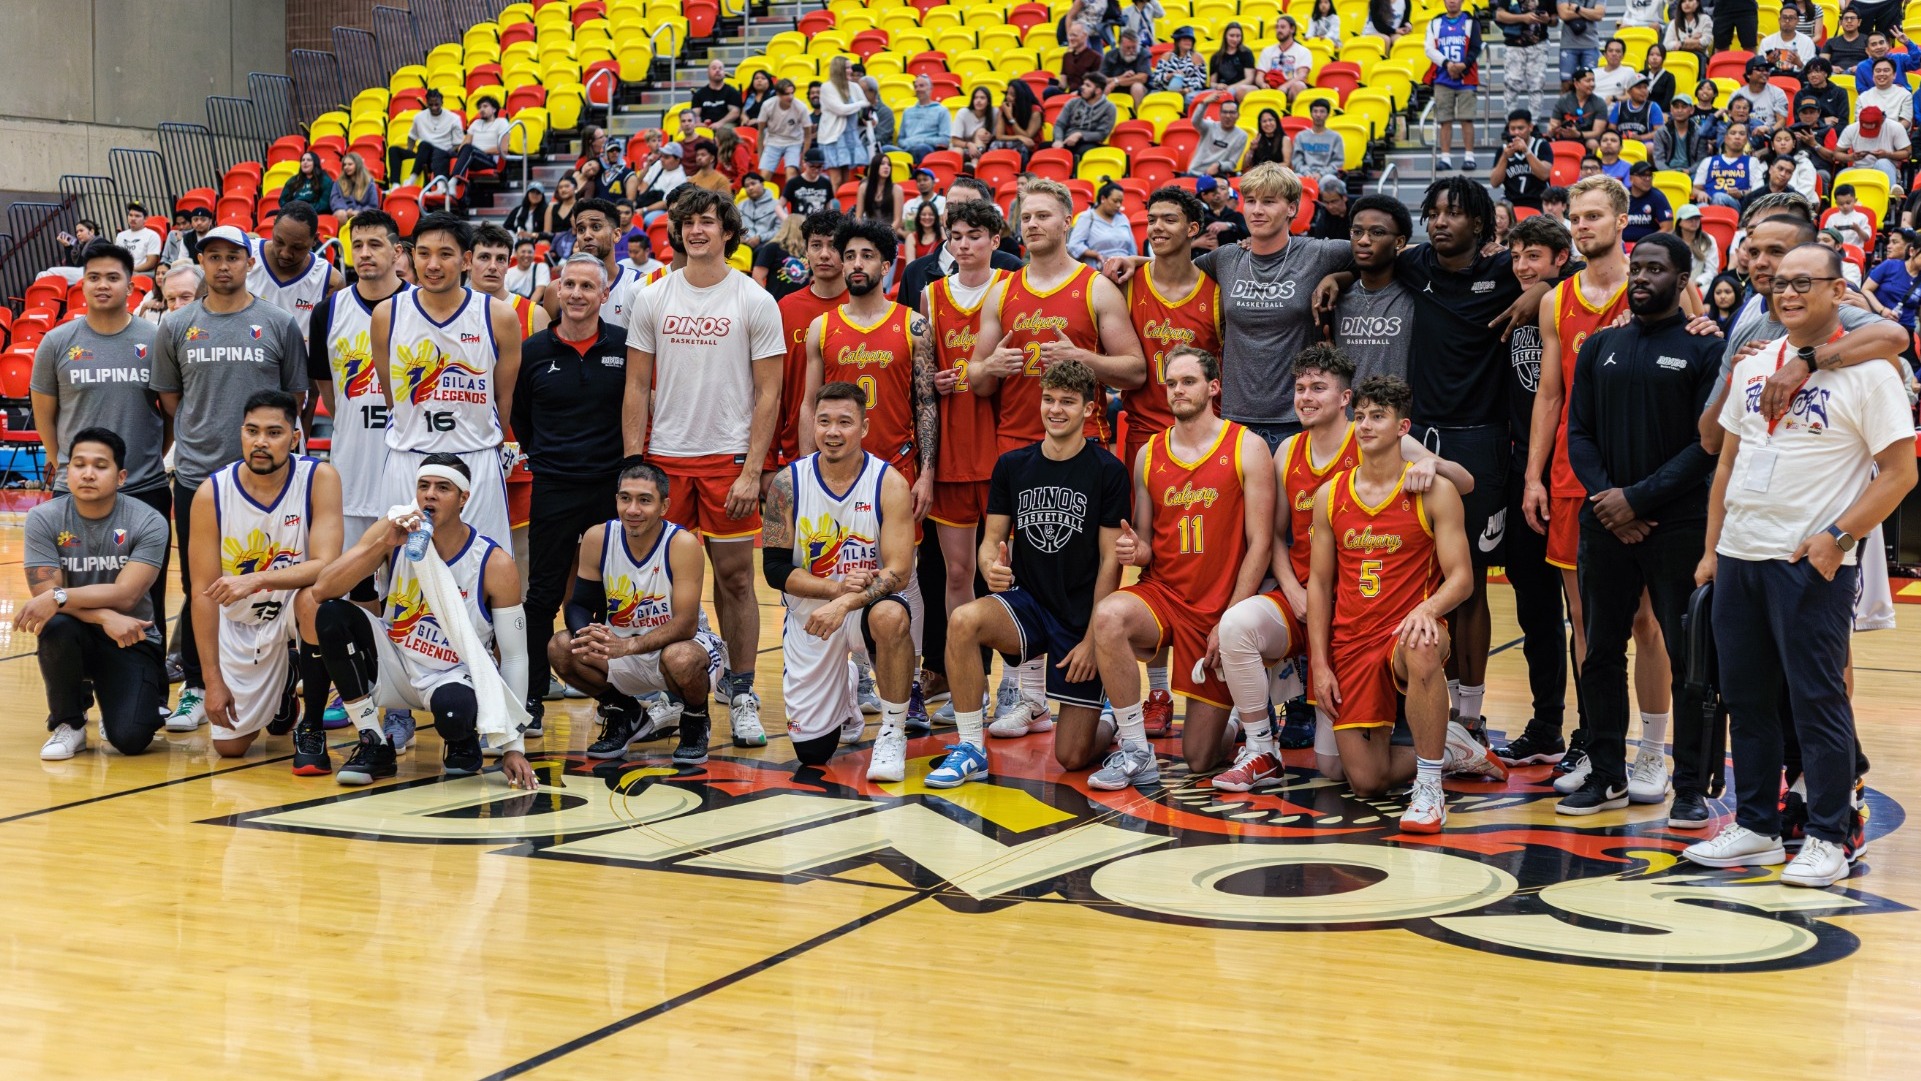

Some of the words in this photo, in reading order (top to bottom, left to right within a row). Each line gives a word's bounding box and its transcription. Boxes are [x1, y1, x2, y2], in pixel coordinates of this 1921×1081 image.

[1518, 176, 1528, 194] 7
[1230, 280, 1297, 301] DINOS
[662, 315, 731, 338] DINOS
[1013, 308, 1069, 335] Calgary
[1143, 318, 1196, 345] Calgary
[1340, 316, 1403, 338] DINOS
[670, 338, 717, 346] BASKETBALL
[1512, 325, 1543, 352] DIN
[187, 346, 264, 364] PILIPINAS
[838, 342, 894, 369] Calgary
[1024, 341, 1042, 377] 2
[69, 367, 150, 384] PILIPINAS
[1154, 350, 1169, 385] 1
[443, 376, 486, 391] GILAS
[433, 390, 487, 404] LEGENDS
[360, 405, 389, 429] 15
[424, 410, 457, 433] 16
[1017, 486, 1087, 518] DINOS
[1163, 480, 1219, 510] Calgary
[1017, 512, 1084, 531] BASKETBALL
[1177, 514, 1204, 554] 11
[1343, 524, 1402, 554] Calgary
[60, 555, 129, 573] PILIPINAS
[1359, 559, 1383, 598] 5
[637, 602, 669, 618] GIAS
[417, 624, 450, 647] GILA
[404, 635, 460, 664] LEGENDS
[235, 768, 1875, 967] DINOS
